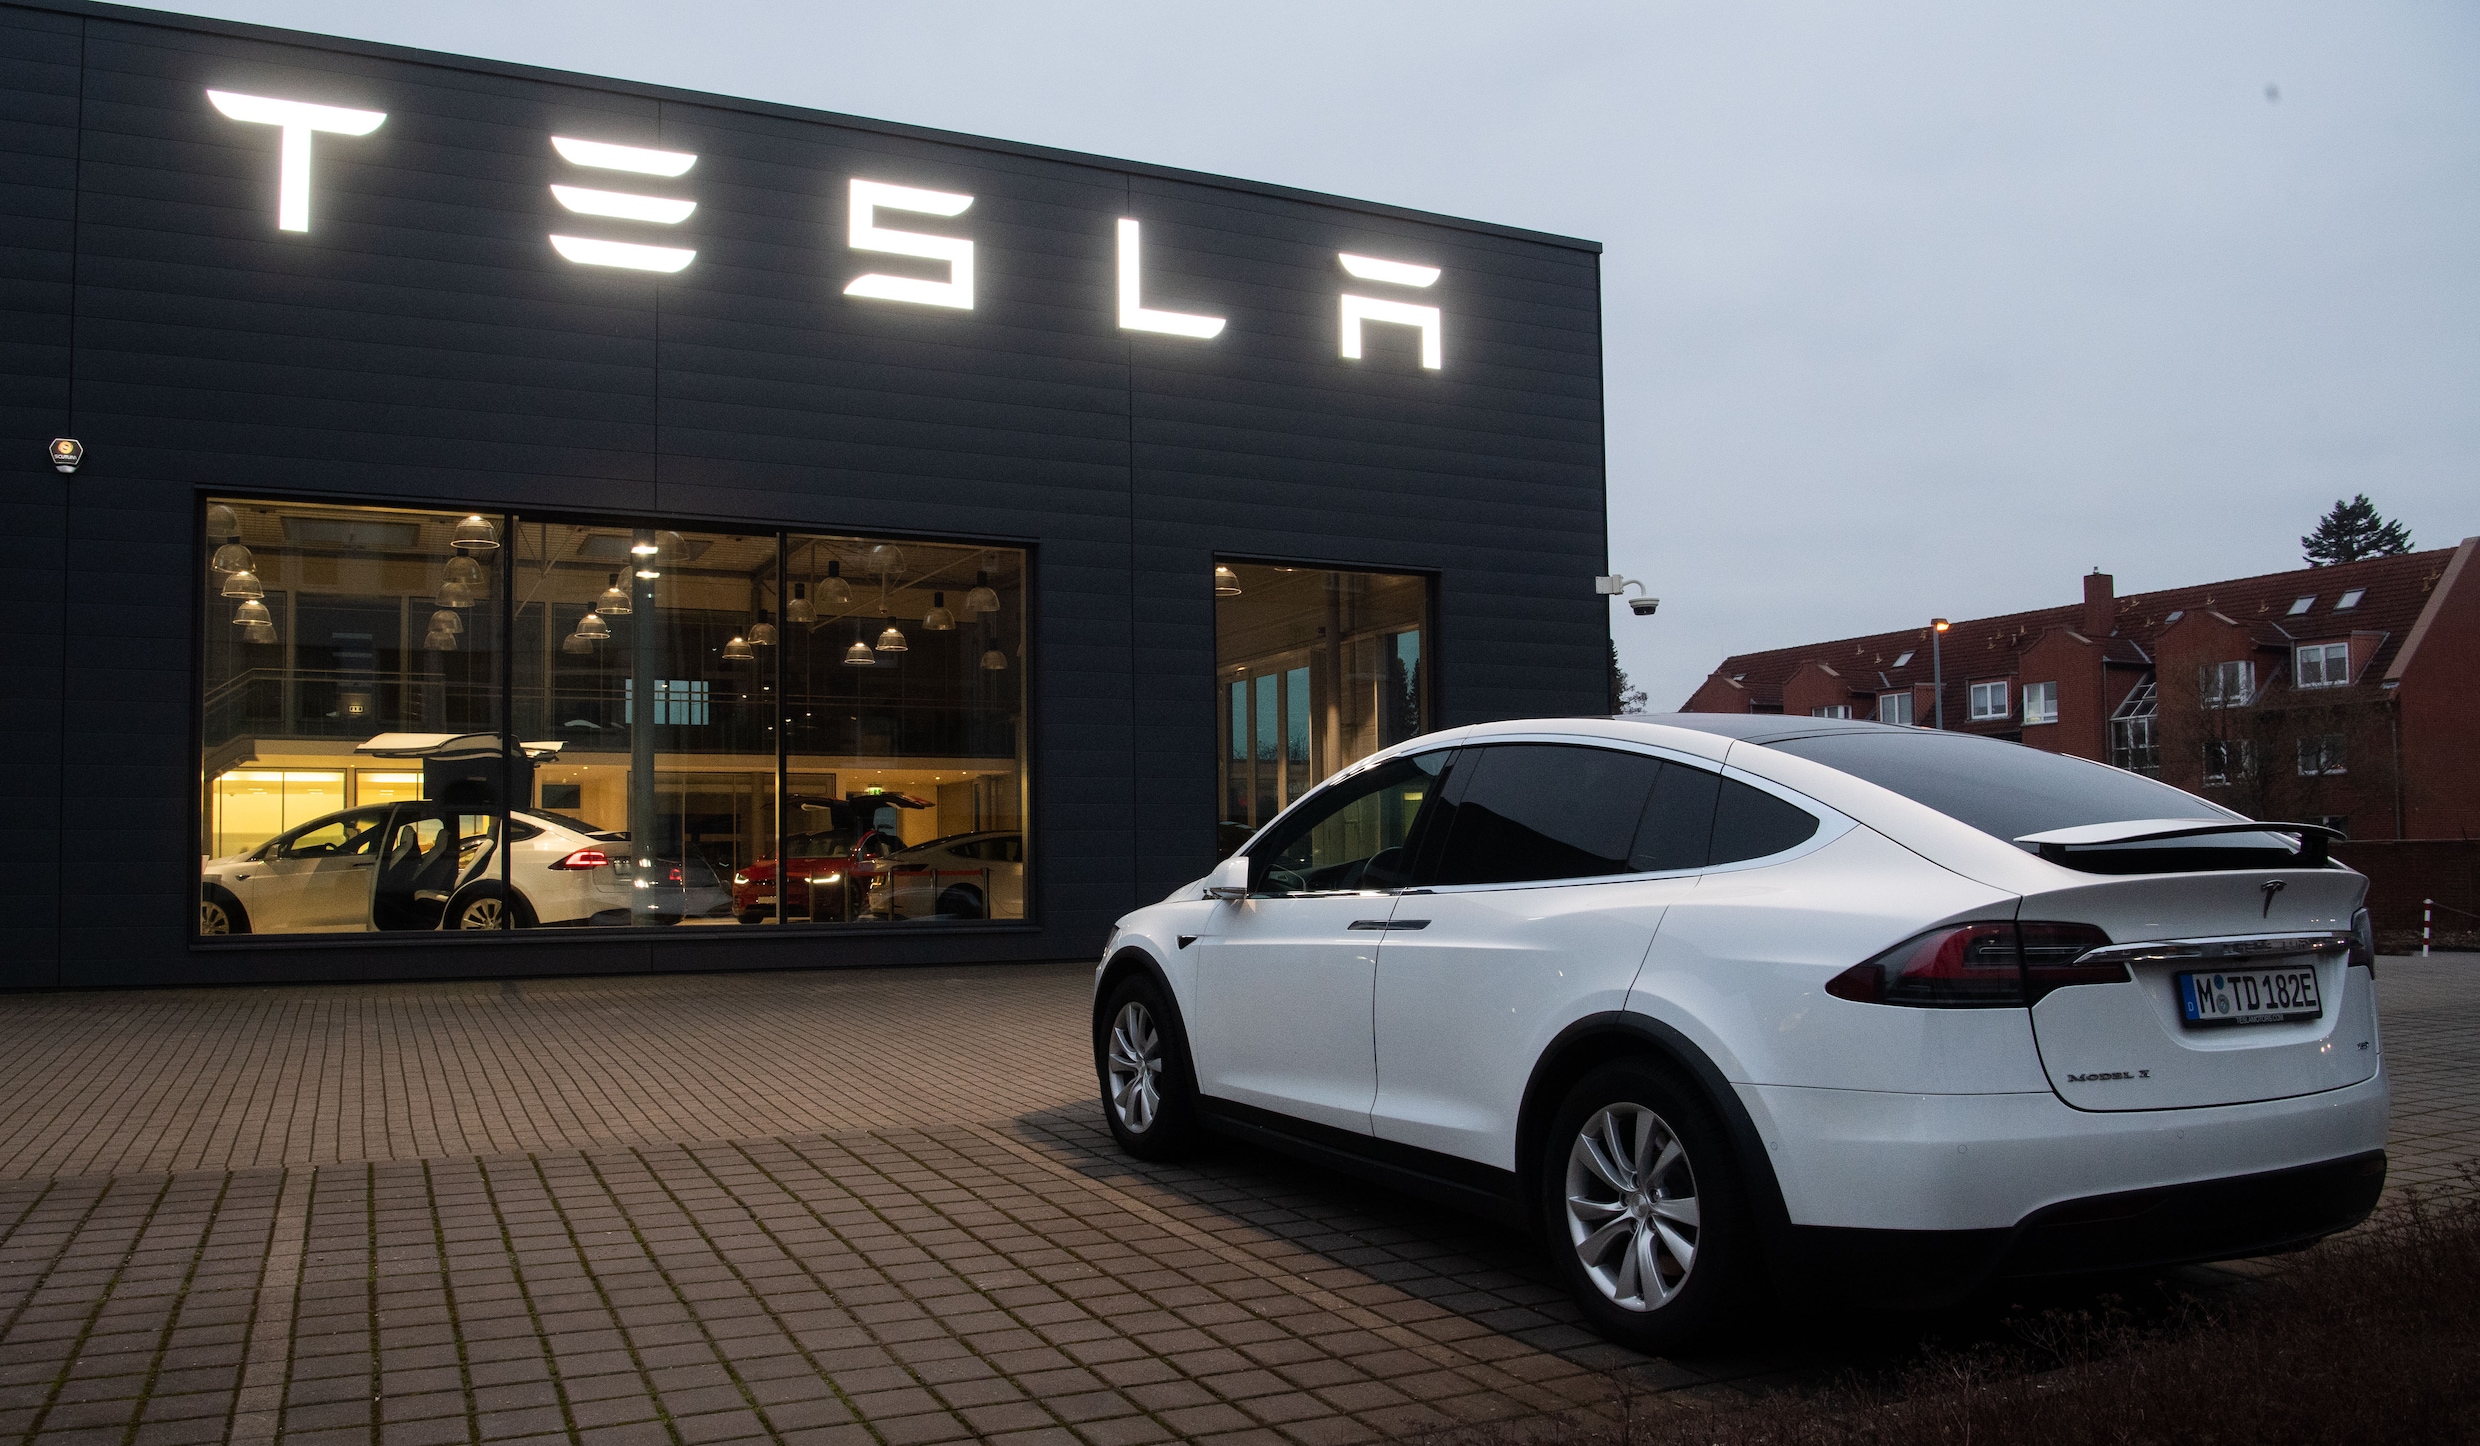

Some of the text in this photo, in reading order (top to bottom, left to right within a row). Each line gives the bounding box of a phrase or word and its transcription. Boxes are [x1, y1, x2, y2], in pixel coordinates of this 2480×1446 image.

[206, 88, 1441, 370] TESLA
[2187, 1001, 2195, 1012] D
[2196, 978, 2216, 1014] M
[2067, 1069, 2151, 1083] MODEL X
